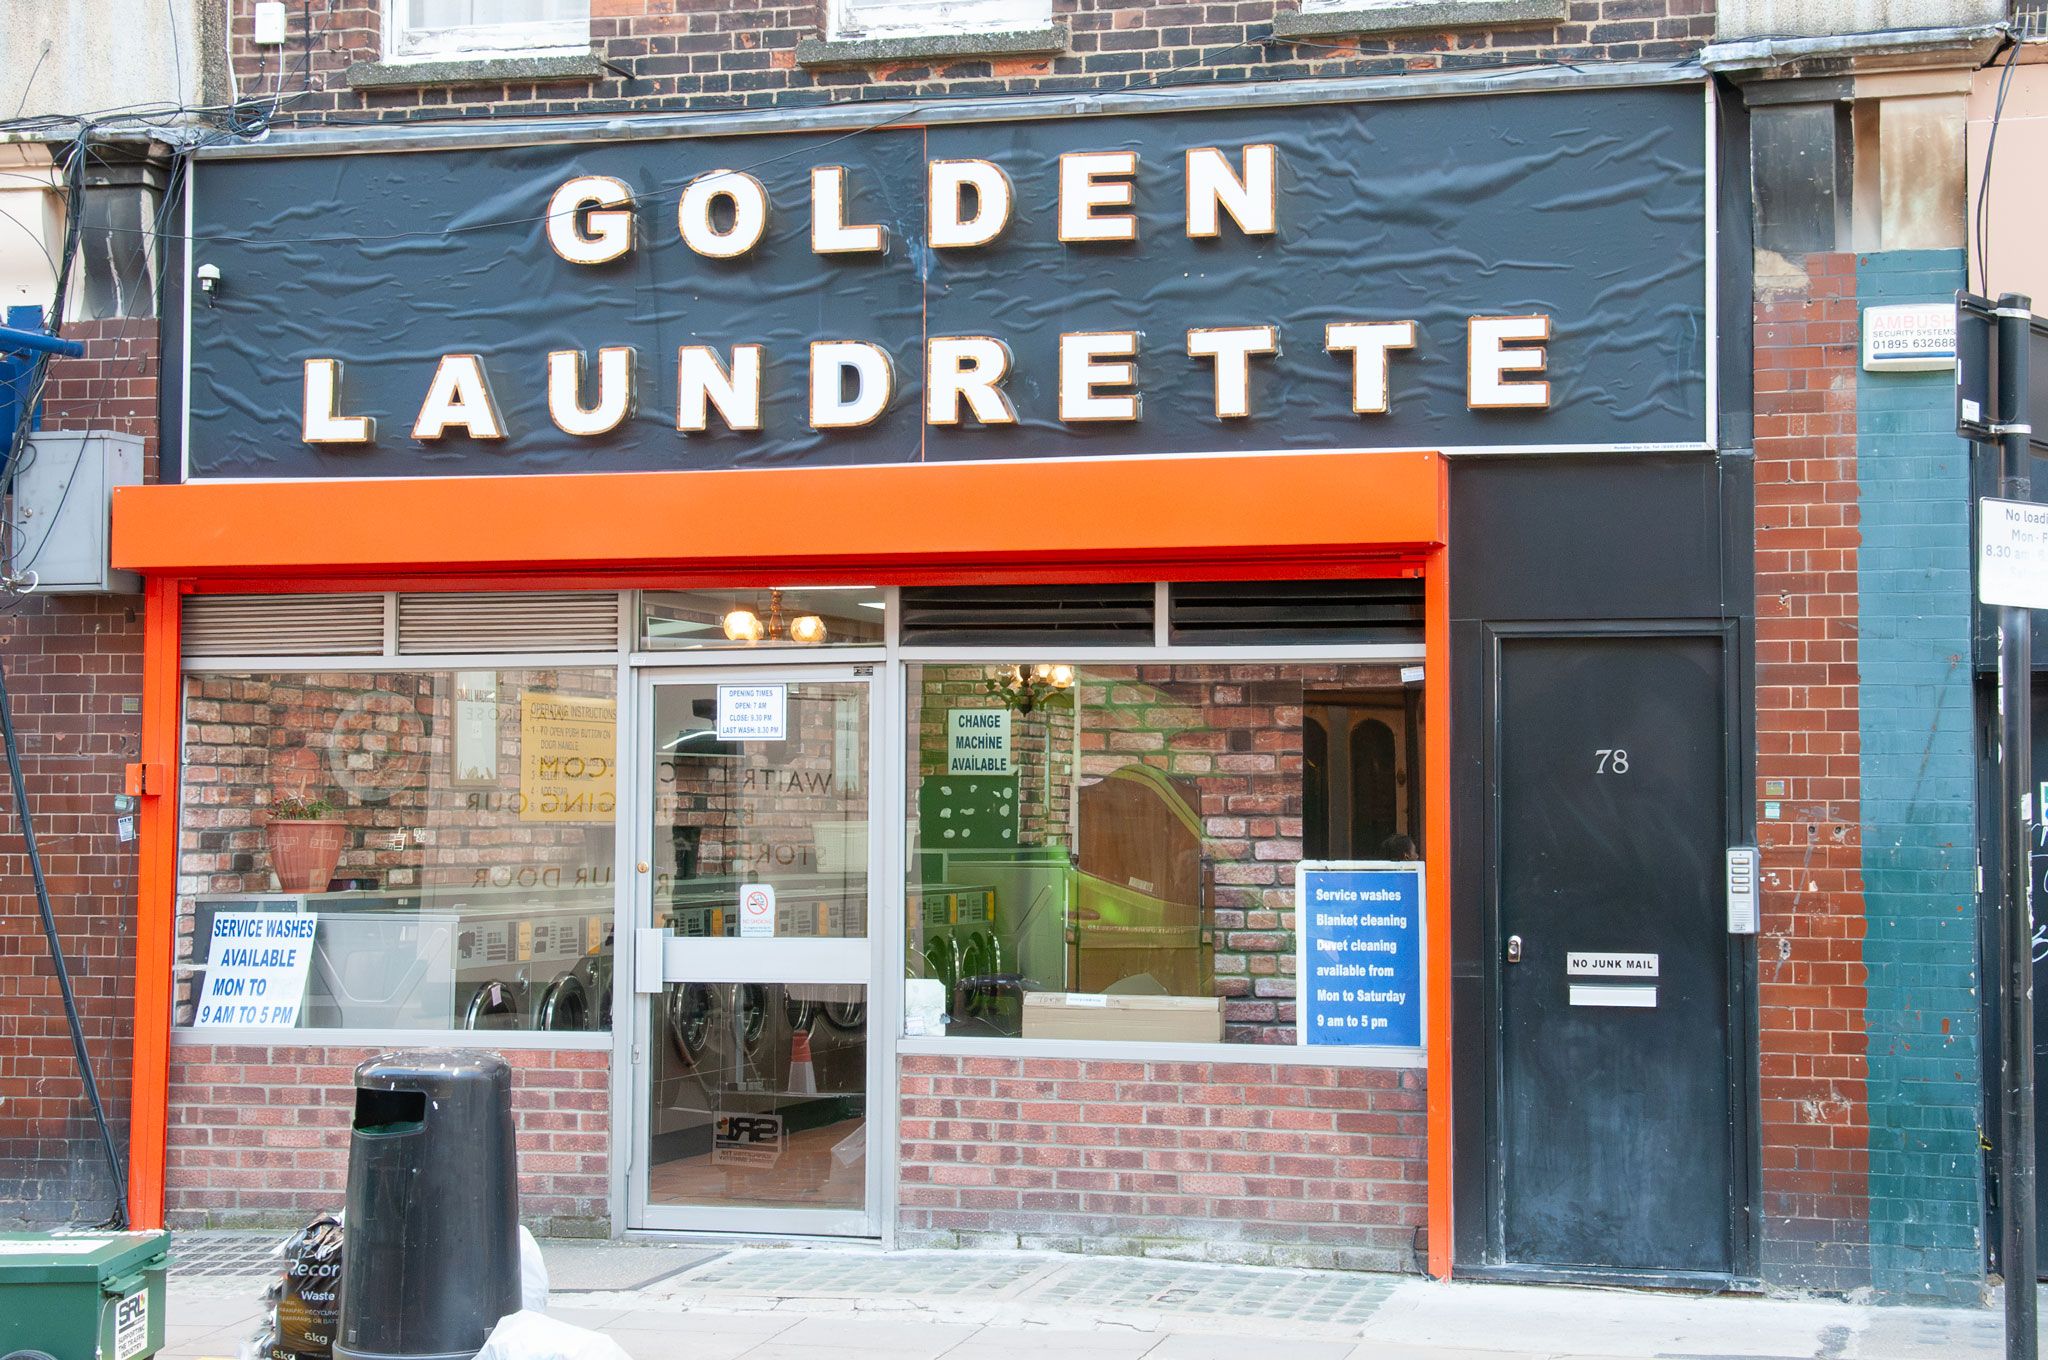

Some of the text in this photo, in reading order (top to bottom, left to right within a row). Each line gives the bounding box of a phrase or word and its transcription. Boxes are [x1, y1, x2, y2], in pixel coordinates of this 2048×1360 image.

[546, 144, 1278, 265] GOLDEN
[1874, 314, 1955, 330] AMBUSH
[1873, 330, 1914, 338] SECURITY
[1873, 338, 1956, 350] 01895 632688
[302, 314, 1552, 444] LAUNDRETTE
[2006, 509, 2021, 521] No
[2012, 530, 2034, 543] Mon
[1986, 545, 2011, 558] 8.30
[530, 702, 617, 720] OPERATING INSTRUCTIONS
[959, 715, 1001, 728] CHANGE
[1595, 750, 1629, 774] 78
[1316, 889, 1401, 901] Service washes
[214, 919, 314, 938] SERVICE WASHES
[1316, 914, 1407, 929] Blanket cleaning
[1317, 939, 1397, 955] Duvet cleaning
[221, 949, 297, 968] AVAILABLE
[1573, 959, 1653, 969] NO JUNK MAIL
[1317, 965, 1394, 977] available from
[212, 978, 267, 996] MON TO
[1317, 989, 1406, 1005] Mon to Saturday
[201, 1006, 294, 1024] 9 AM TO 5 PM
[1317, 1015, 1388, 1030] 9 am to 5 pm
[301, 1291, 335, 1301] Waste
[119, 1295, 145, 1326] SRL
[118, 1325, 145, 1344] SUPPORTING
[118, 1334, 145, 1351] THE TRAFFIC
[305, 1332, 328, 1345] 6kg
[121, 1343, 142, 1359] INDUSTRY
[273, 1350, 296, 1360] 6kg
